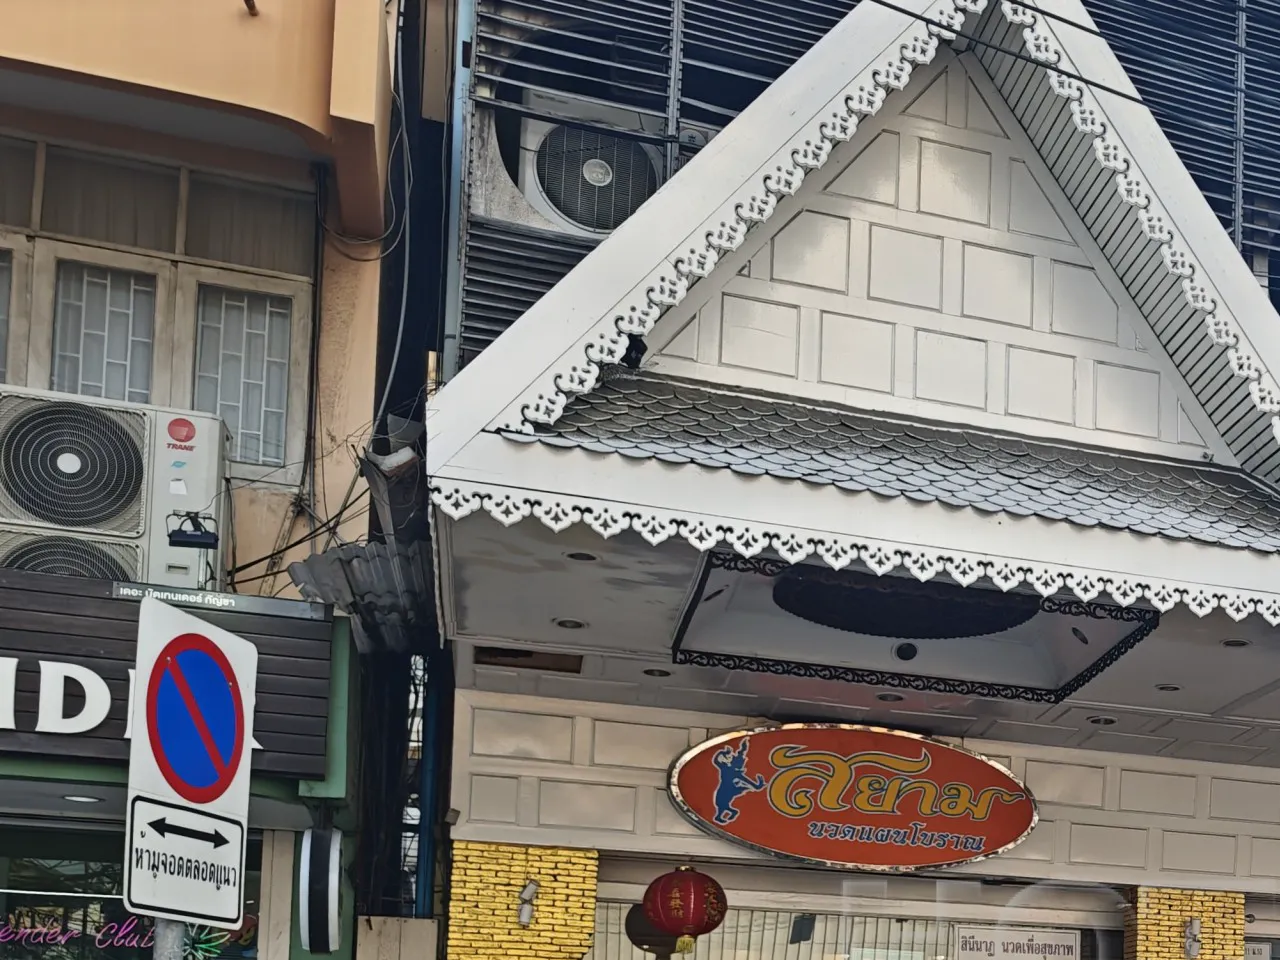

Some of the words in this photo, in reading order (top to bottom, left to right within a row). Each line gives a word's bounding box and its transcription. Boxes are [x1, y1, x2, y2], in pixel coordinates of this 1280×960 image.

[166, 443, 196, 451] TRANE
[767, 744, 1025, 821] สยาม
[808, 821, 986, 852] นวดแผนโบราณ
[0, 919, 81, 947] ender
